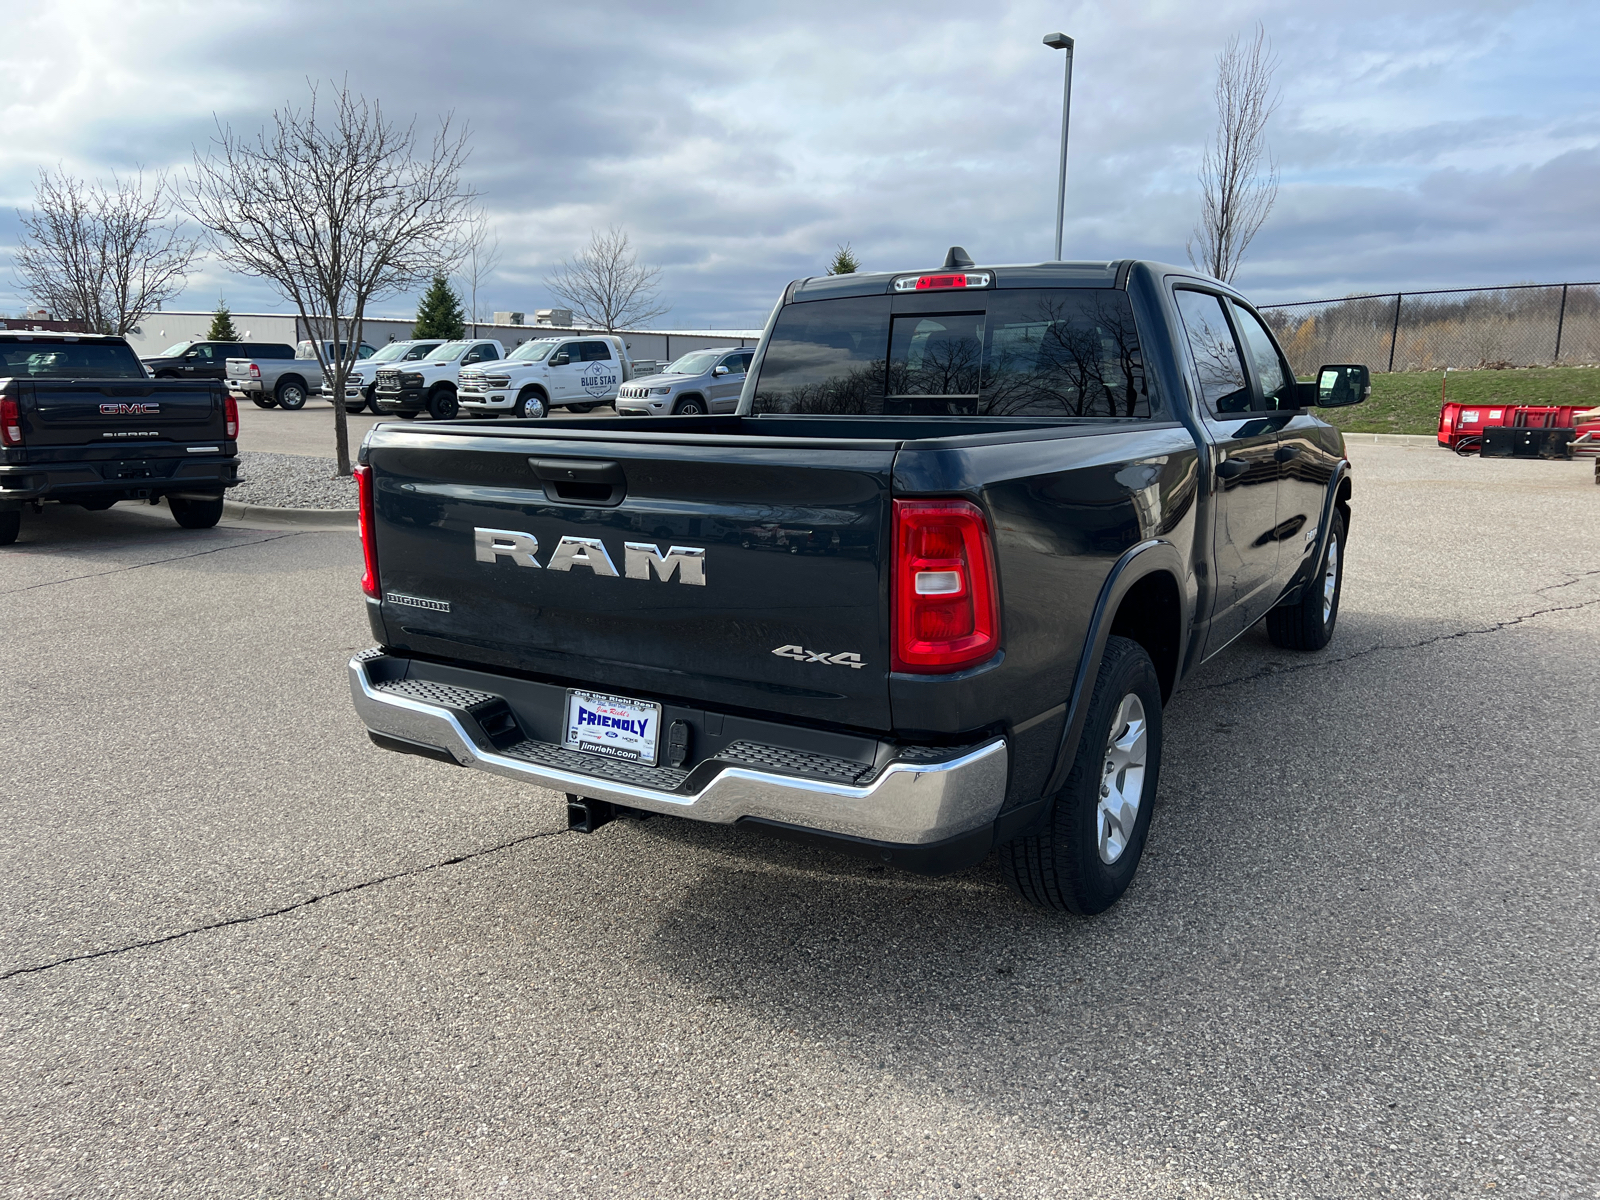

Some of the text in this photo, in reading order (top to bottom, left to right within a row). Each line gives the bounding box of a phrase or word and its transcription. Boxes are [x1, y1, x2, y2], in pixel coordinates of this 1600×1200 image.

[581, 375, 617, 386] BLUE STAR
[99, 403, 160, 414] GMC
[473, 526, 707, 586] RAM
[387, 592, 450, 613] BIGHORN
[771, 643, 868, 669] 4x4
[609, 696, 632, 704] Riehl
[633, 700, 654, 708] Deal
[596, 705, 608, 714] Jim
[609, 708, 630, 718] Riehl's
[578, 705, 649, 739] FRIENDLY
[580, 742, 637, 760] jimriehl.com
